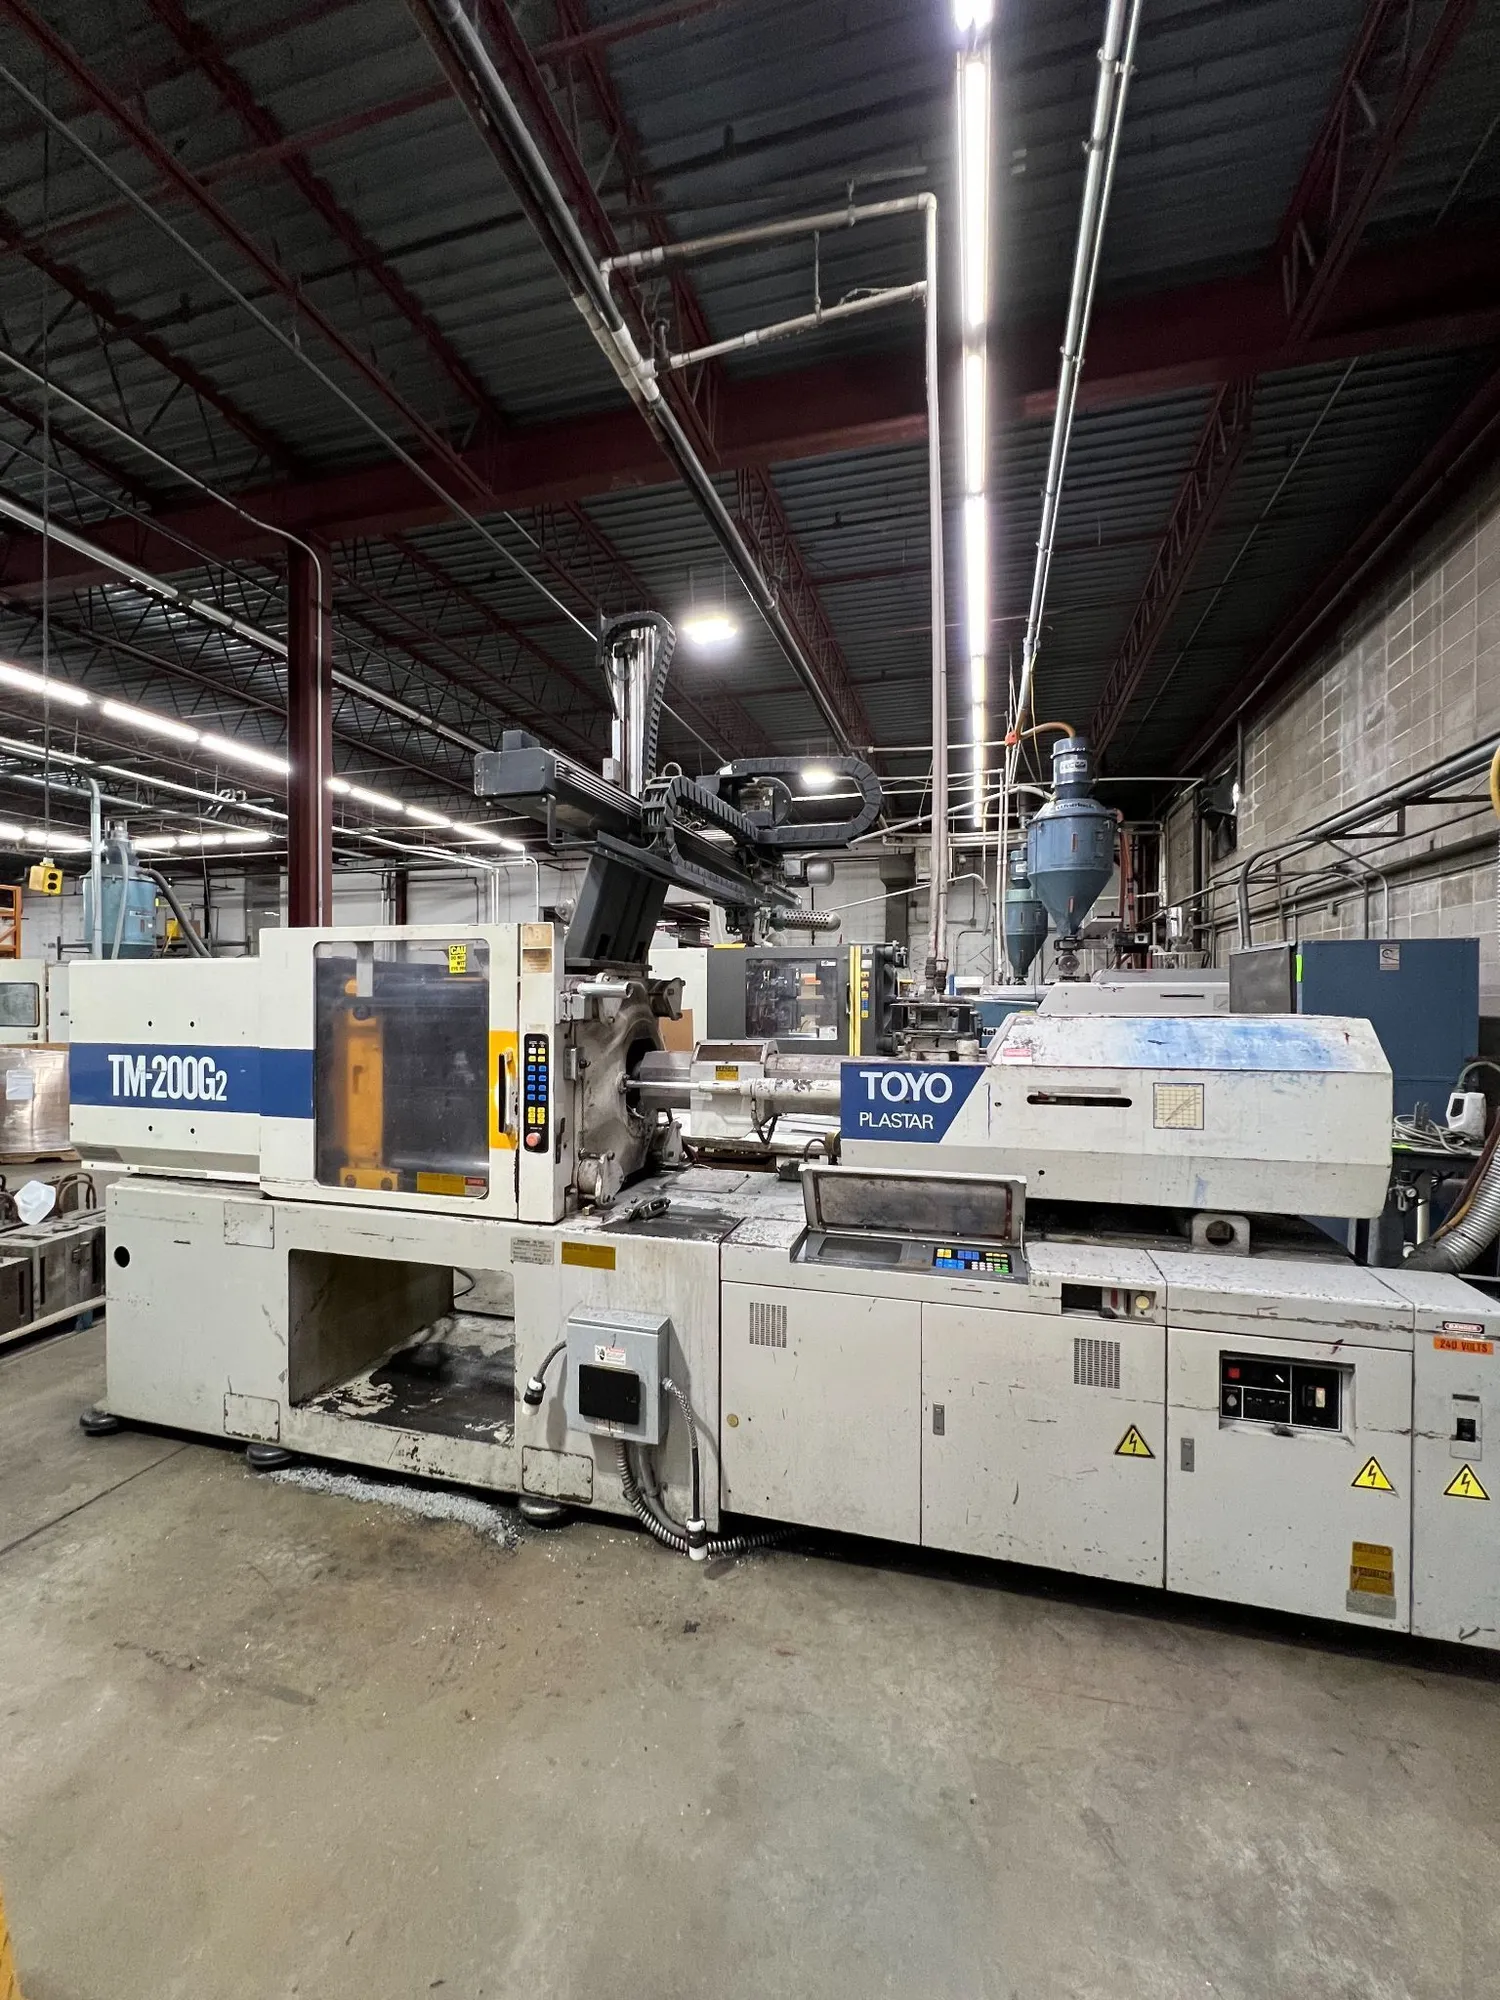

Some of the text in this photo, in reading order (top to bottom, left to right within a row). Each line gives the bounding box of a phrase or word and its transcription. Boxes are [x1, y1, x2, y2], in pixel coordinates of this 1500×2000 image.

[107, 1054, 228, 1101] TM-200G2
[859, 1071, 953, 1104] TOYO
[860, 1111, 934, 1130] PLASTAR
[1440, 1339, 1488, 1353] 240 VOLTS
